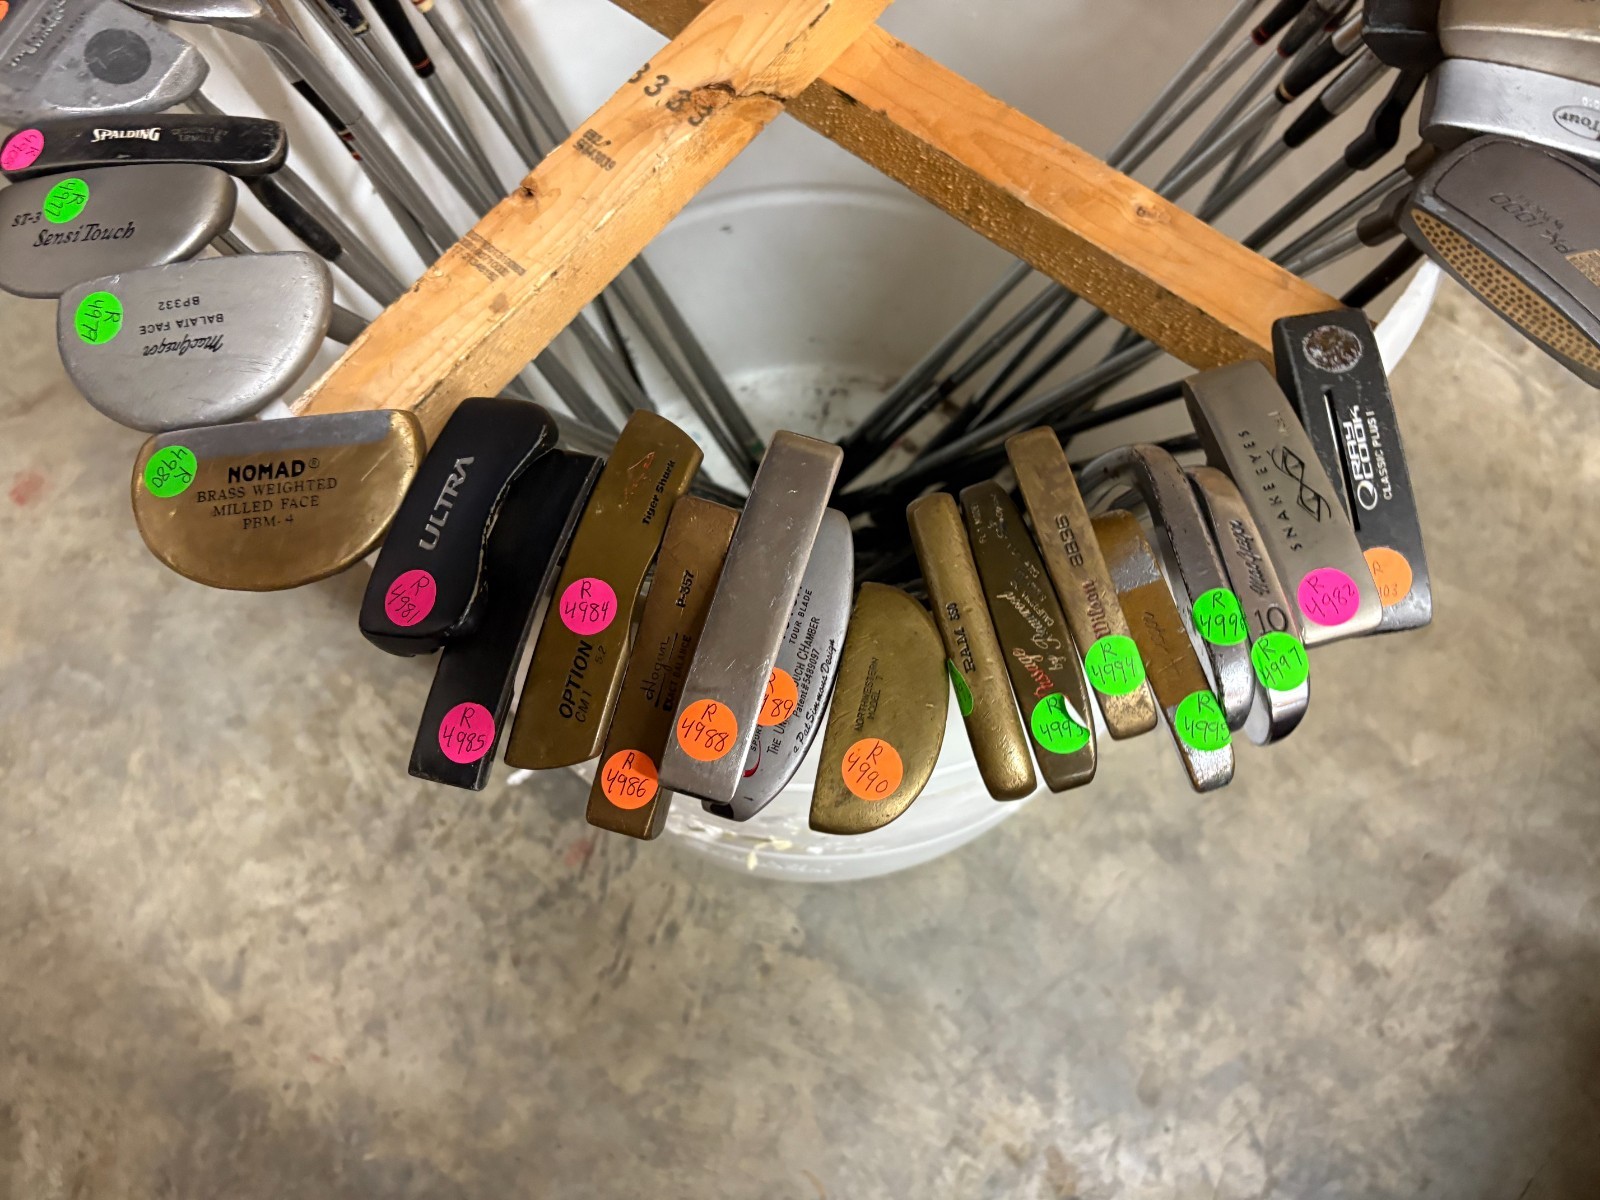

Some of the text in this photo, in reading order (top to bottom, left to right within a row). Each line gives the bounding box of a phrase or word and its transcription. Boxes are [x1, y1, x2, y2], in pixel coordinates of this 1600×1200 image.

[91, 127, 162, 143] SPALDING
[68, 191, 87, 206] R
[11, 212, 42, 227] ST-3
[158, 295, 201, 311] BP332
[103, 310, 122, 325] R
[139, 313, 225, 336] BALATA FACE
[142, 333, 225, 357] MacGregor
[1342, 420, 1364, 481] RAY
[1348, 404, 1375, 480] COOK
[150, 447, 189, 490] 4980
[172, 466, 194, 485] R
[227, 458, 307, 485] NOMAD
[1374, 448, 1393, 501] CLASSIC
[196, 477, 339, 504] BRASS WEIGHTED
[418, 455, 476, 551] ULTRA
[641, 460, 677, 526] Tiger Shark
[210, 495, 320, 518] MILLED FACE
[1372, 559, 1384, 577] R
[410, 574, 430, 597] R
[579, 579, 593, 600] R
[675, 569, 695, 608] P-357
[1306, 575, 1326, 595] R
[387, 583, 421, 624] 4981
[564, 600, 610, 623] 4984
[1081, 577, 1112, 641] Wilson
[1211, 590, 1226, 610] R
[1304, 582, 1357, 620] 4982
[788, 620, 803, 645] TOUR
[797, 588, 814, 620] BLADE
[1254, 605, 1290, 636] 10
[796, 615, 821, 663] CHAMBER
[953, 625, 977, 675] RAM
[1100, 641, 1118, 664] R
[1256, 637, 1277, 664] R
[640, 635, 674, 701] Hogan
[671, 633, 693, 678] BALANCE
[1047, 652, 1068, 672] by
[1258, 645, 1304, 686] 4997
[558, 639, 595, 719] OPTION
[1090, 655, 1137, 687] 4994
[795, 723, 813, 747] Pat
[819, 638, 836, 677] Design
[853, 656, 880, 733] NORTHWESTERN
[867, 688, 882, 721] MODEL
[1045, 696, 1063, 716] R
[1197, 691, 1216, 714] R
[459, 706, 476, 729] R
[700, 702, 718, 723] R
[442, 725, 487, 755] 4985
[680, 717, 730, 753] 4988
[766, 735, 783, 757] THE
[621, 751, 636, 771] R
[866, 739, 885, 765] R
[606, 767, 650, 798] 4986
[847, 750, 890, 794] 4990
